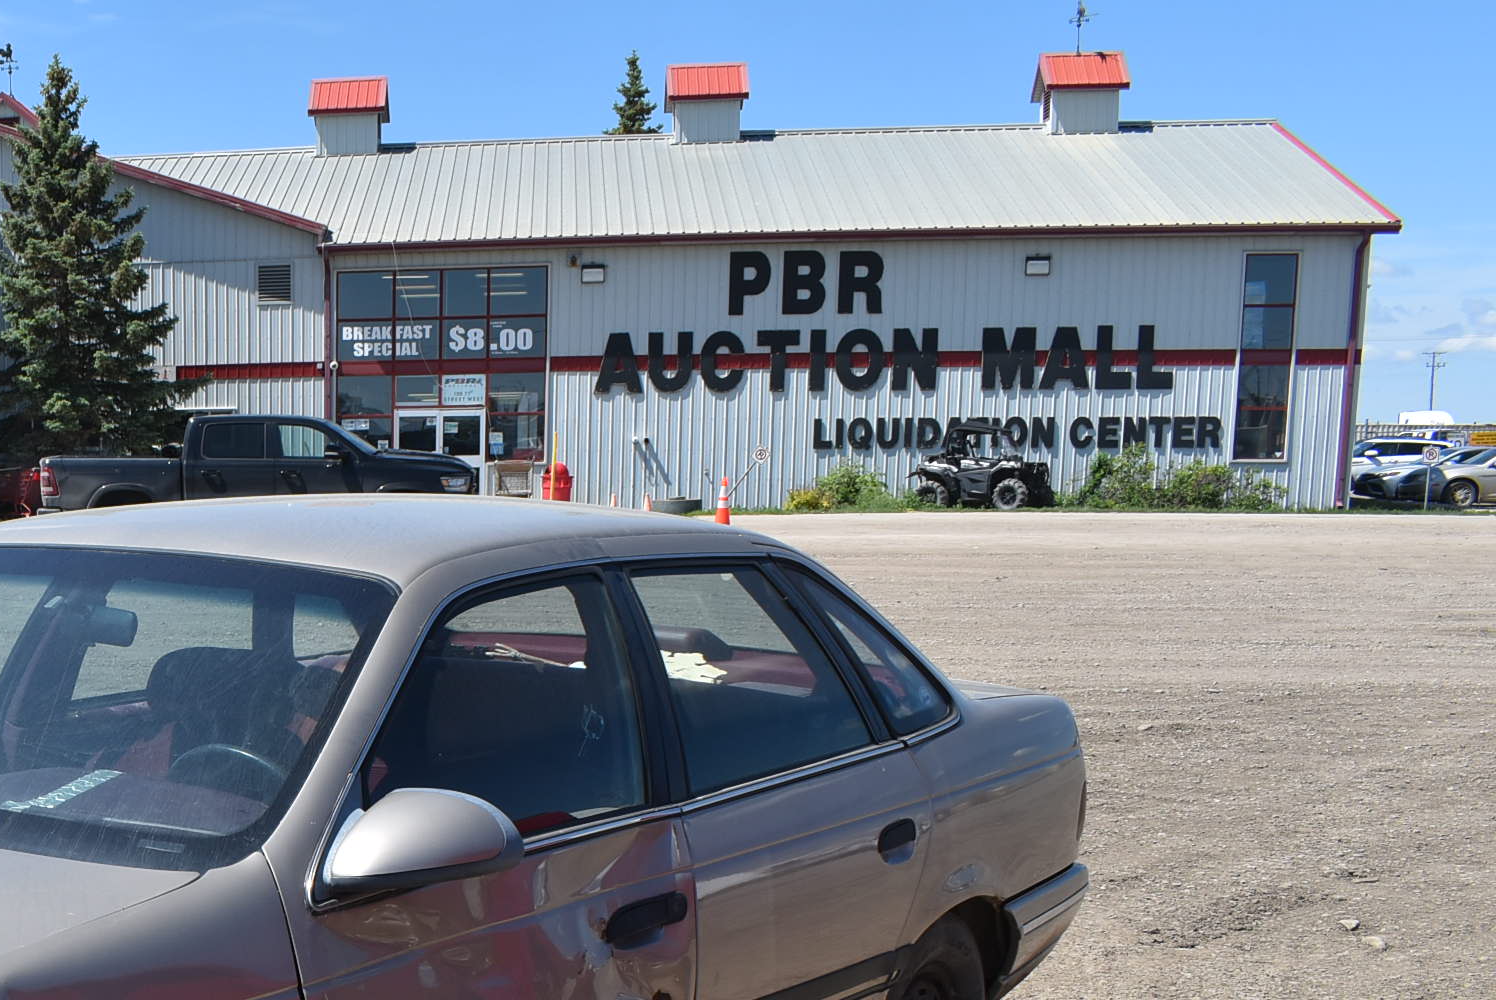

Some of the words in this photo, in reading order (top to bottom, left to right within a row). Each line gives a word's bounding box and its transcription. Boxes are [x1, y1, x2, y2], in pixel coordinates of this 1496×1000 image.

[728, 249, 885, 316] PBR
[342, 324, 433, 341] BREAKFAST
[448, 324, 533, 352] $8.00
[353, 341, 419, 357] SPECIAL
[593, 327, 940, 394] AUCTION
[980, 324, 1174, 390] MALL
[1069, 416, 1222, 450] CENTER
